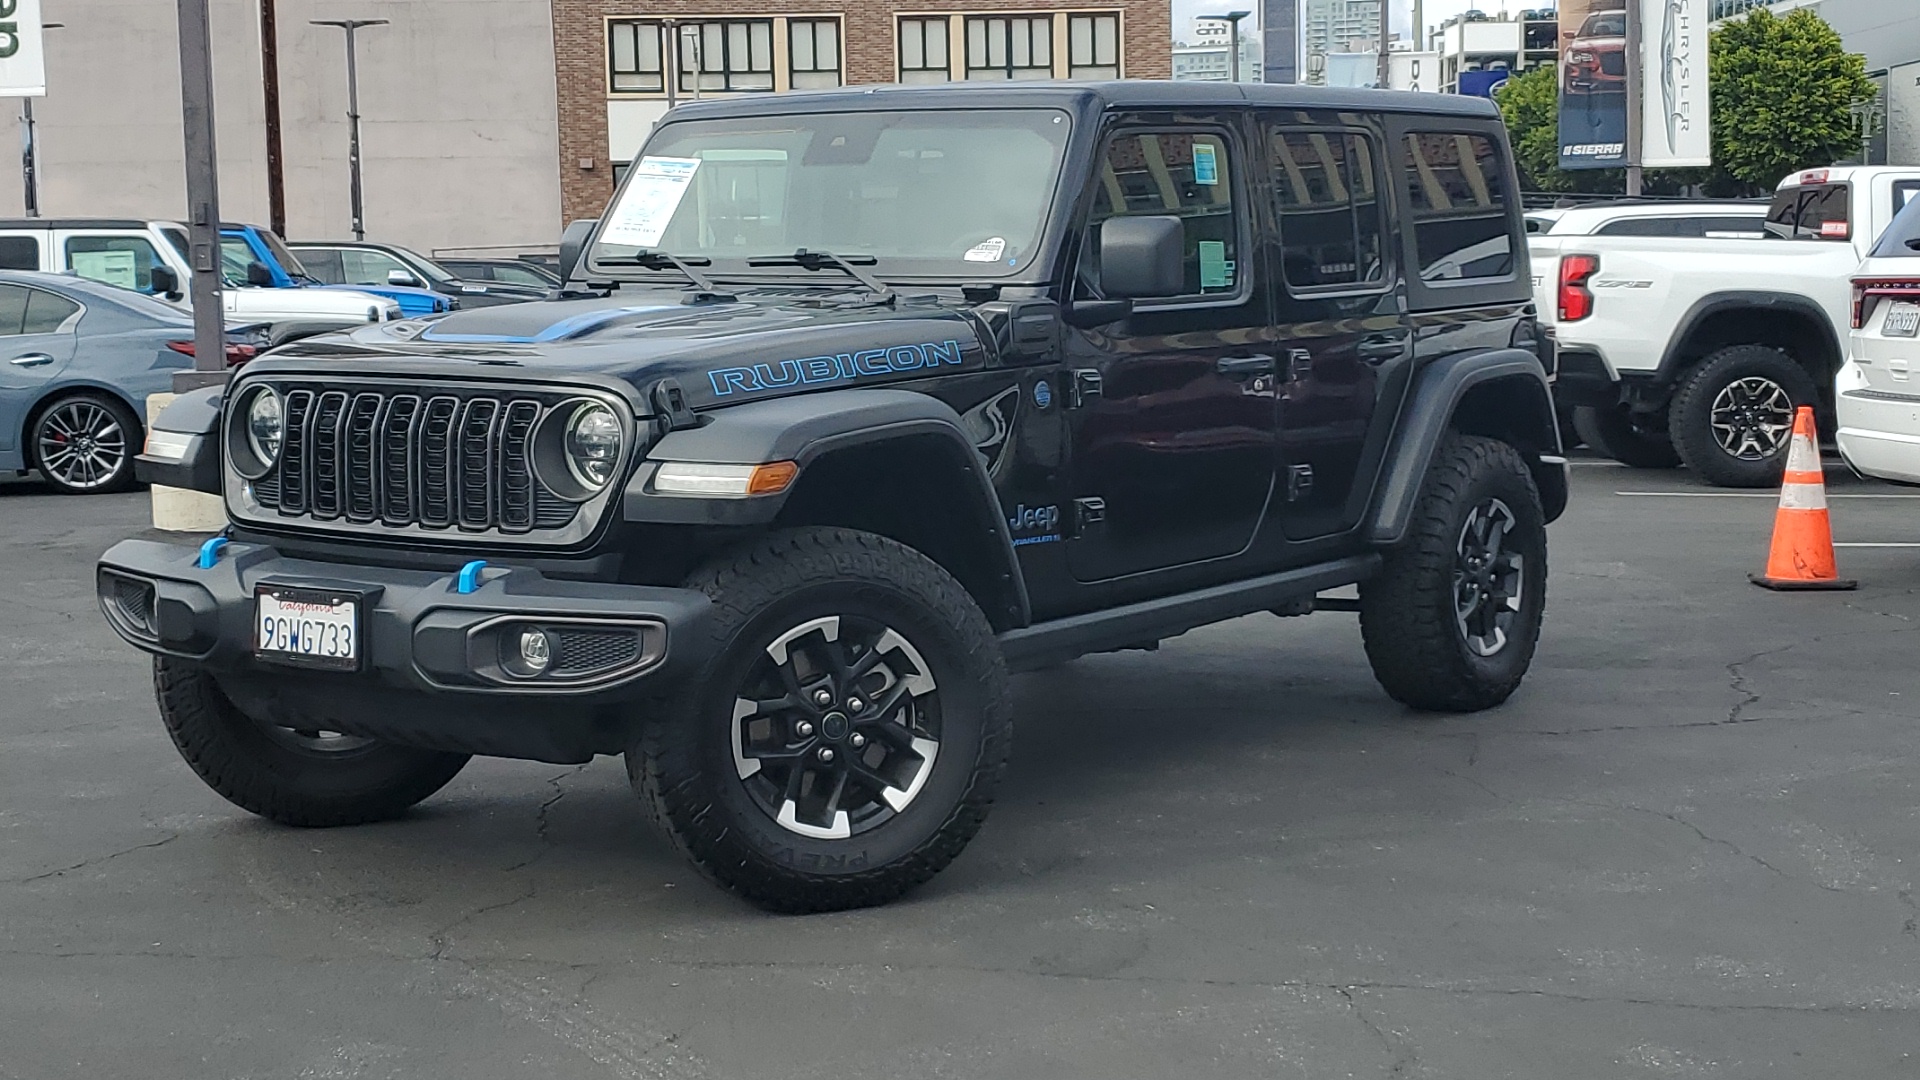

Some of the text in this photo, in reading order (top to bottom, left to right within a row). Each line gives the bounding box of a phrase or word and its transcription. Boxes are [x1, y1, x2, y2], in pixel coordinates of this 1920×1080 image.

[1571, 143, 1624, 155] SIERRA
[708, 340, 962, 396] RUBICON
[1009, 503, 1060, 531] Jeep
[264, 616, 352, 657] 9GWG733
